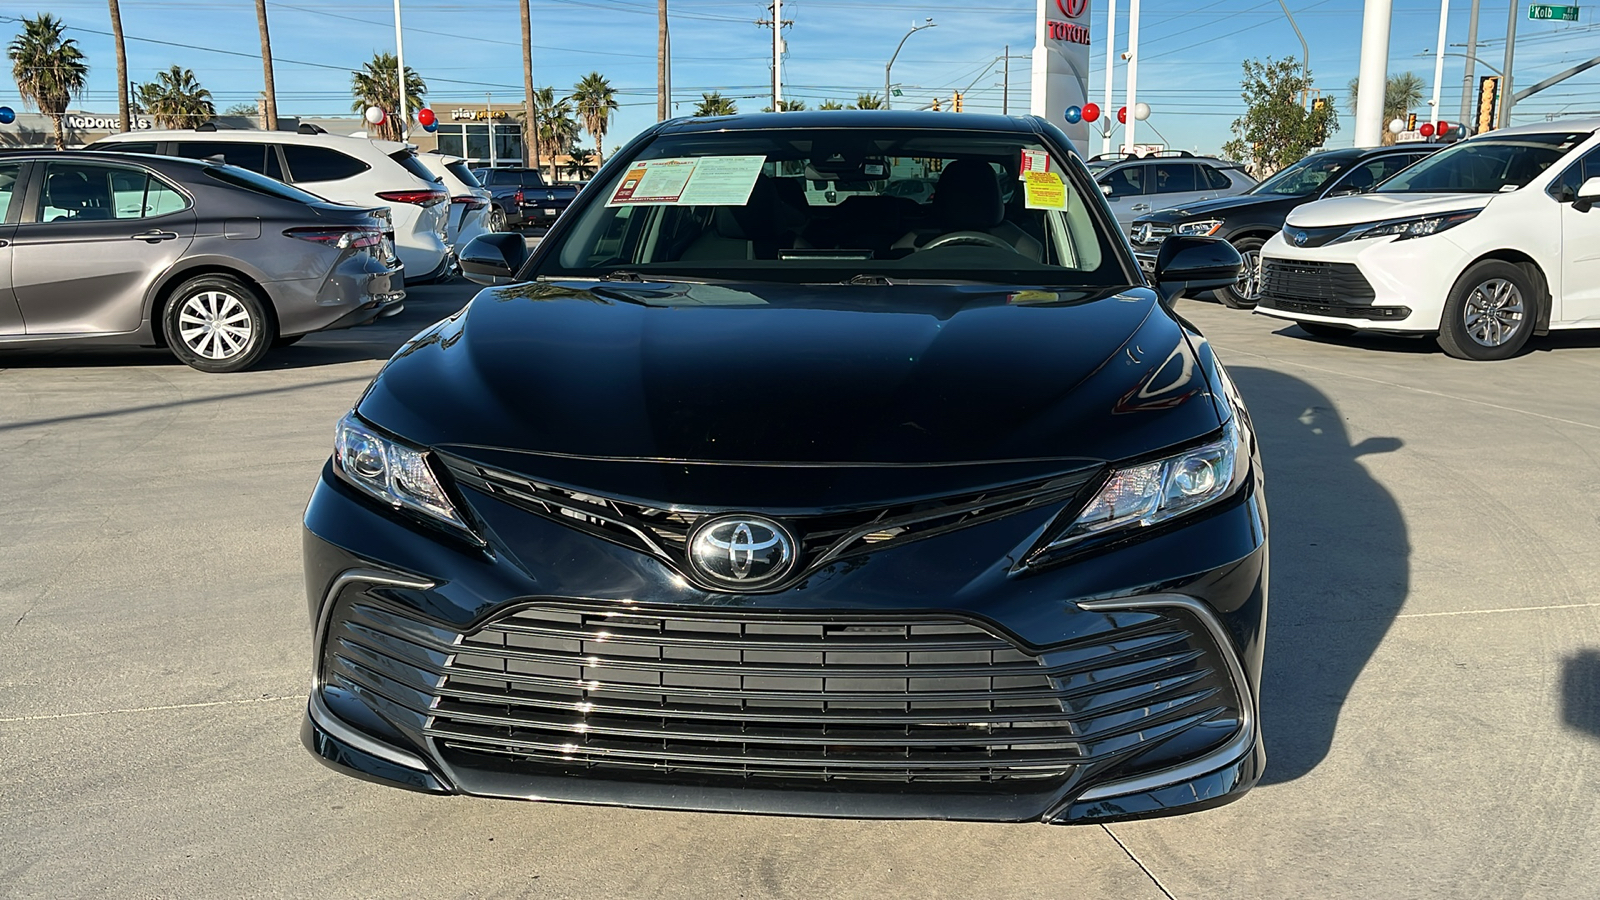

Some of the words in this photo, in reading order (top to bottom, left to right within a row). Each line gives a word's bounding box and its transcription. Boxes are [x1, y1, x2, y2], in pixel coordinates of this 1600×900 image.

[1534, 6, 1553, 18] Kolb
[1047, 21, 1091, 45] TOYOTA
[64, 116, 149, 129] McDonad's
